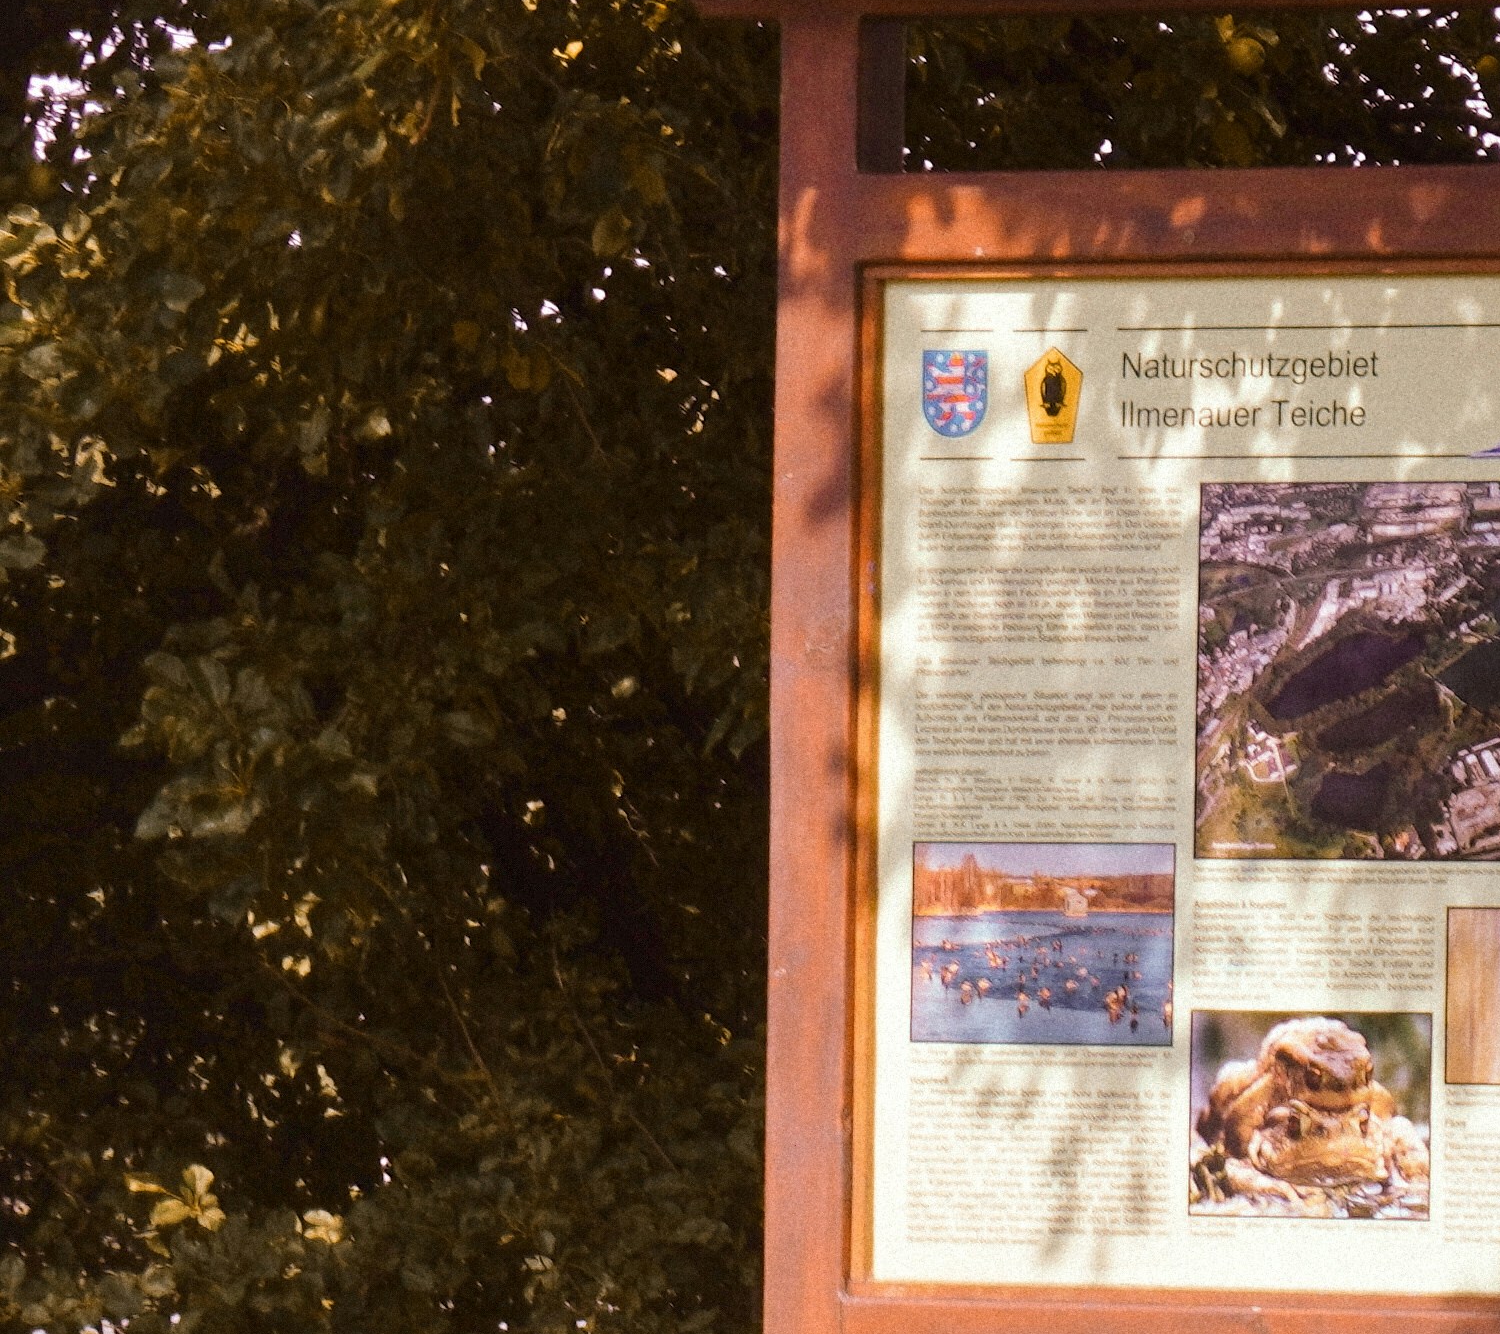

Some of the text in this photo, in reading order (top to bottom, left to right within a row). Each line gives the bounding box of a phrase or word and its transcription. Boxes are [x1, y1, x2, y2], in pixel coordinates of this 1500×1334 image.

[1121, 351, 1379, 384] Naturschutzgebiet
[1121, 399, 1367, 428] Ilmenauer Teiche
